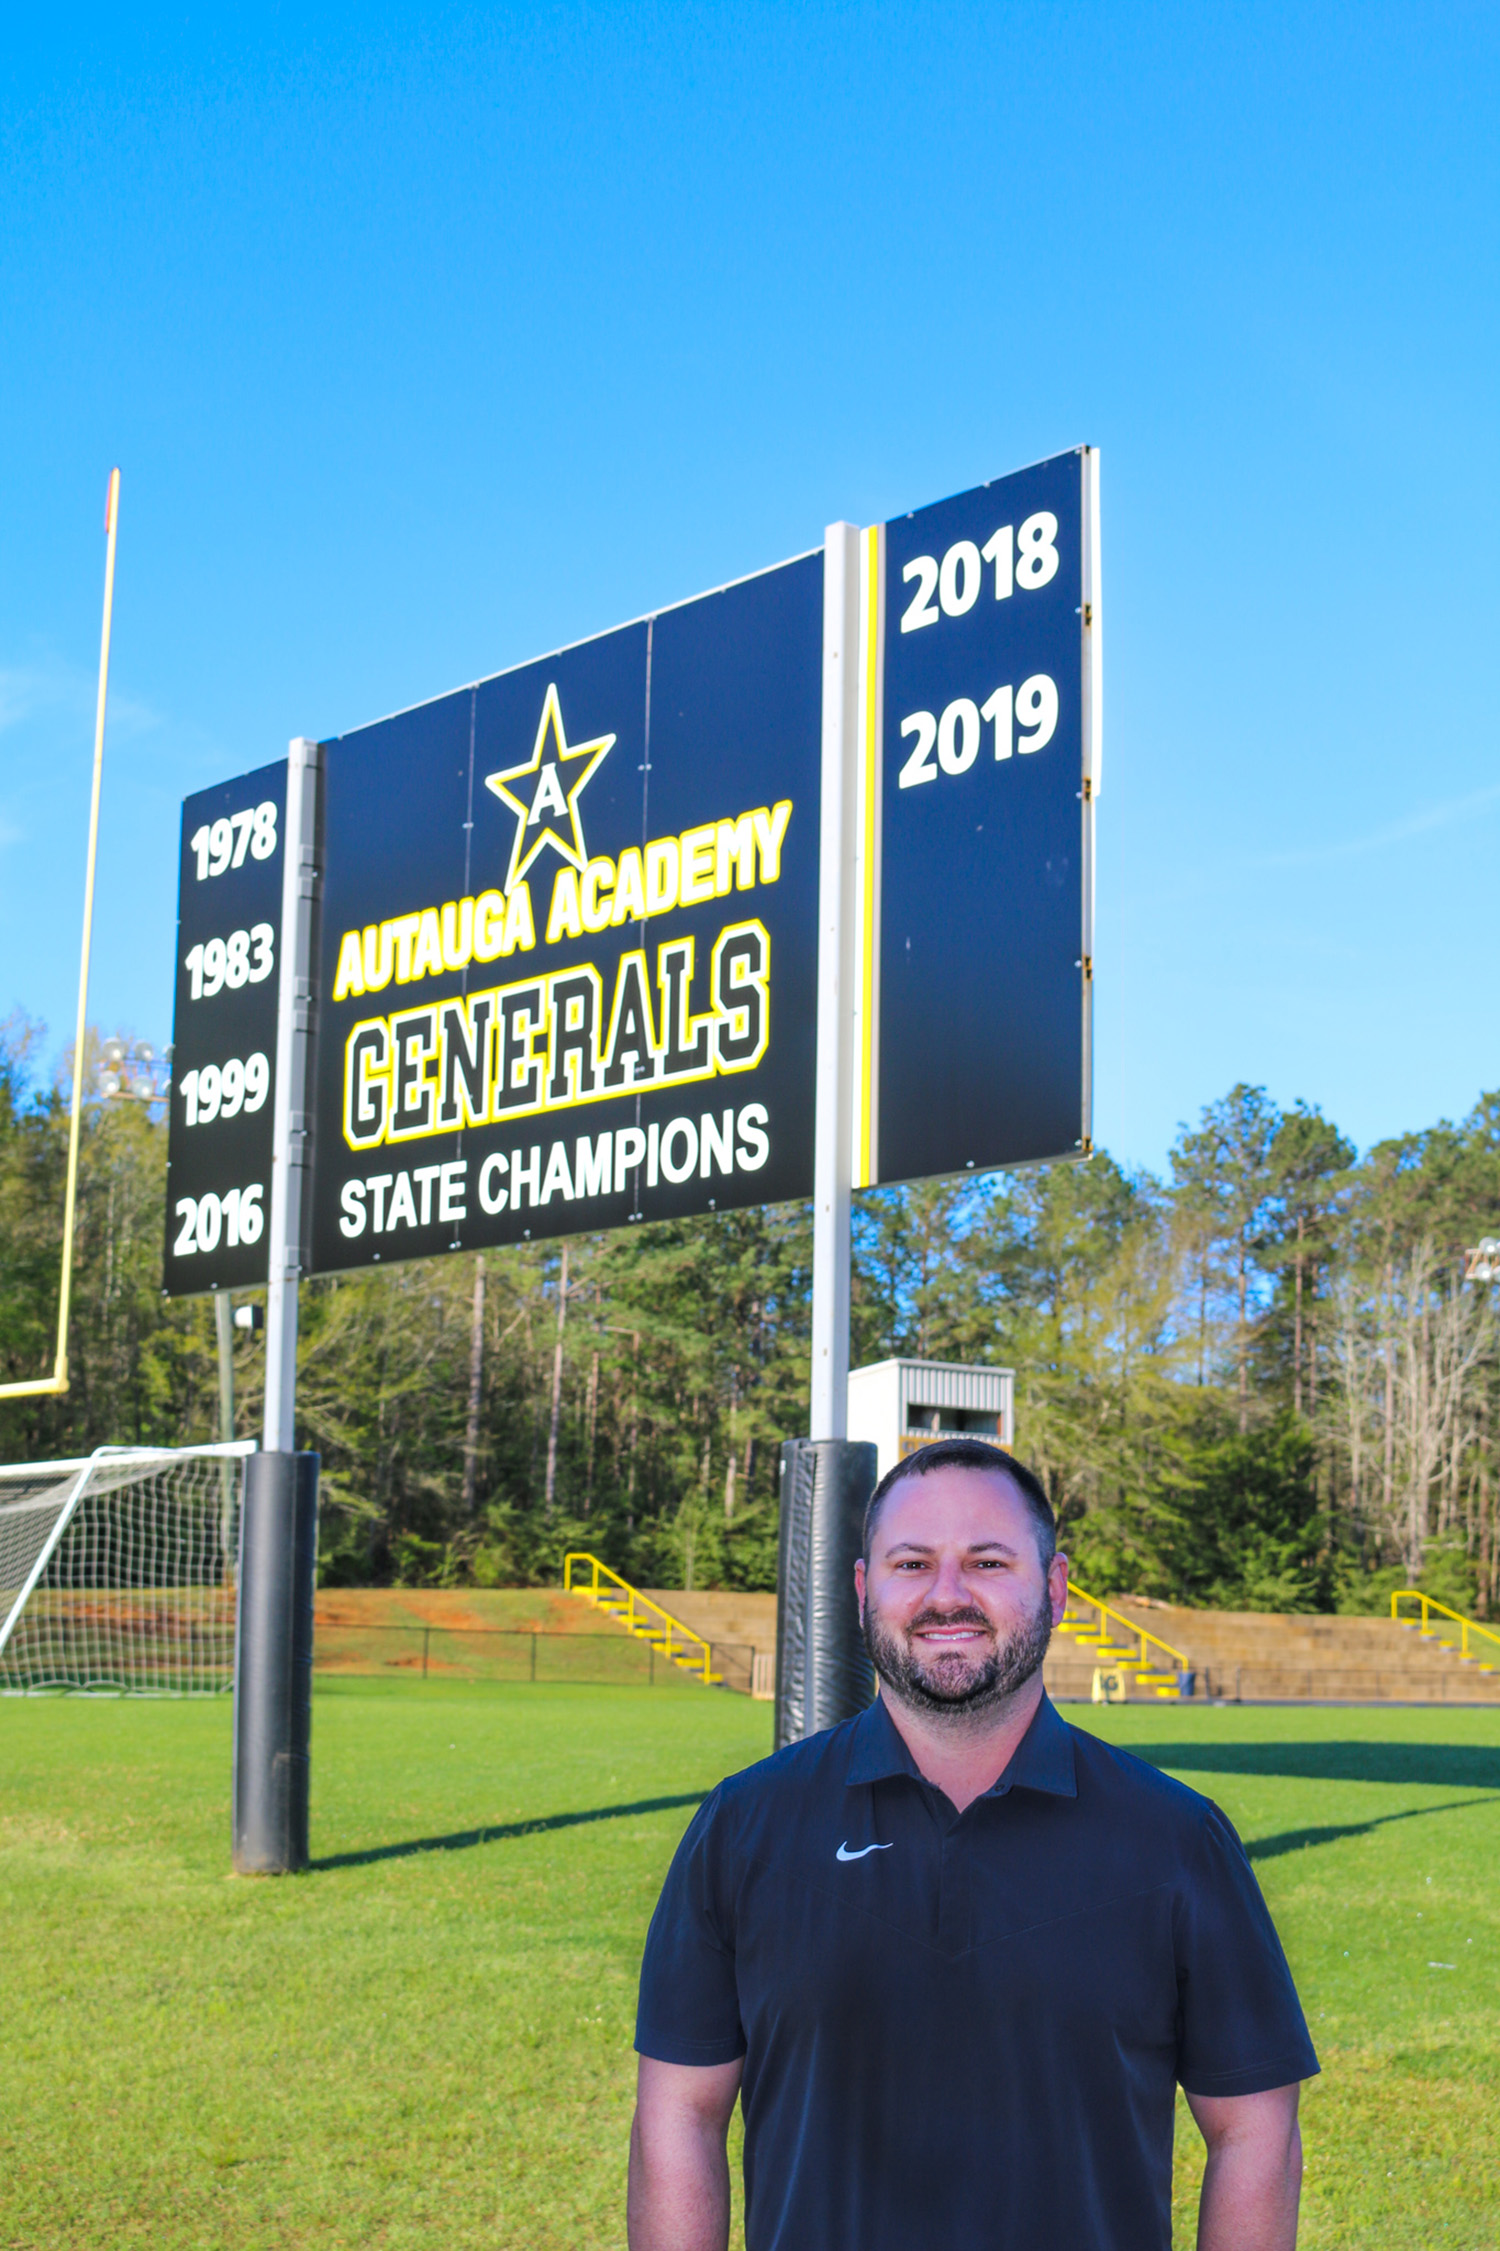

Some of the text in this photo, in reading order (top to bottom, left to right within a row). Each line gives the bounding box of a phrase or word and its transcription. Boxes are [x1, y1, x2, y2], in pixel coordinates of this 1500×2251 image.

[901, 511, 1060, 634] 2018
[899, 673, 1060, 790] 2019
[190, 800, 279, 881] 1978
[528, 762, 569, 826] A
[333, 799, 794, 1001] AUTAUGA ACADEMY
[184, 922, 275, 1001] 1983
[342, 918, 772, 1151] GENERALS
[179, 1052, 271, 1127] 1999
[173, 1182, 265, 1257] 2016
[338, 1102, 771, 1239] STATE CHAMPIONS
